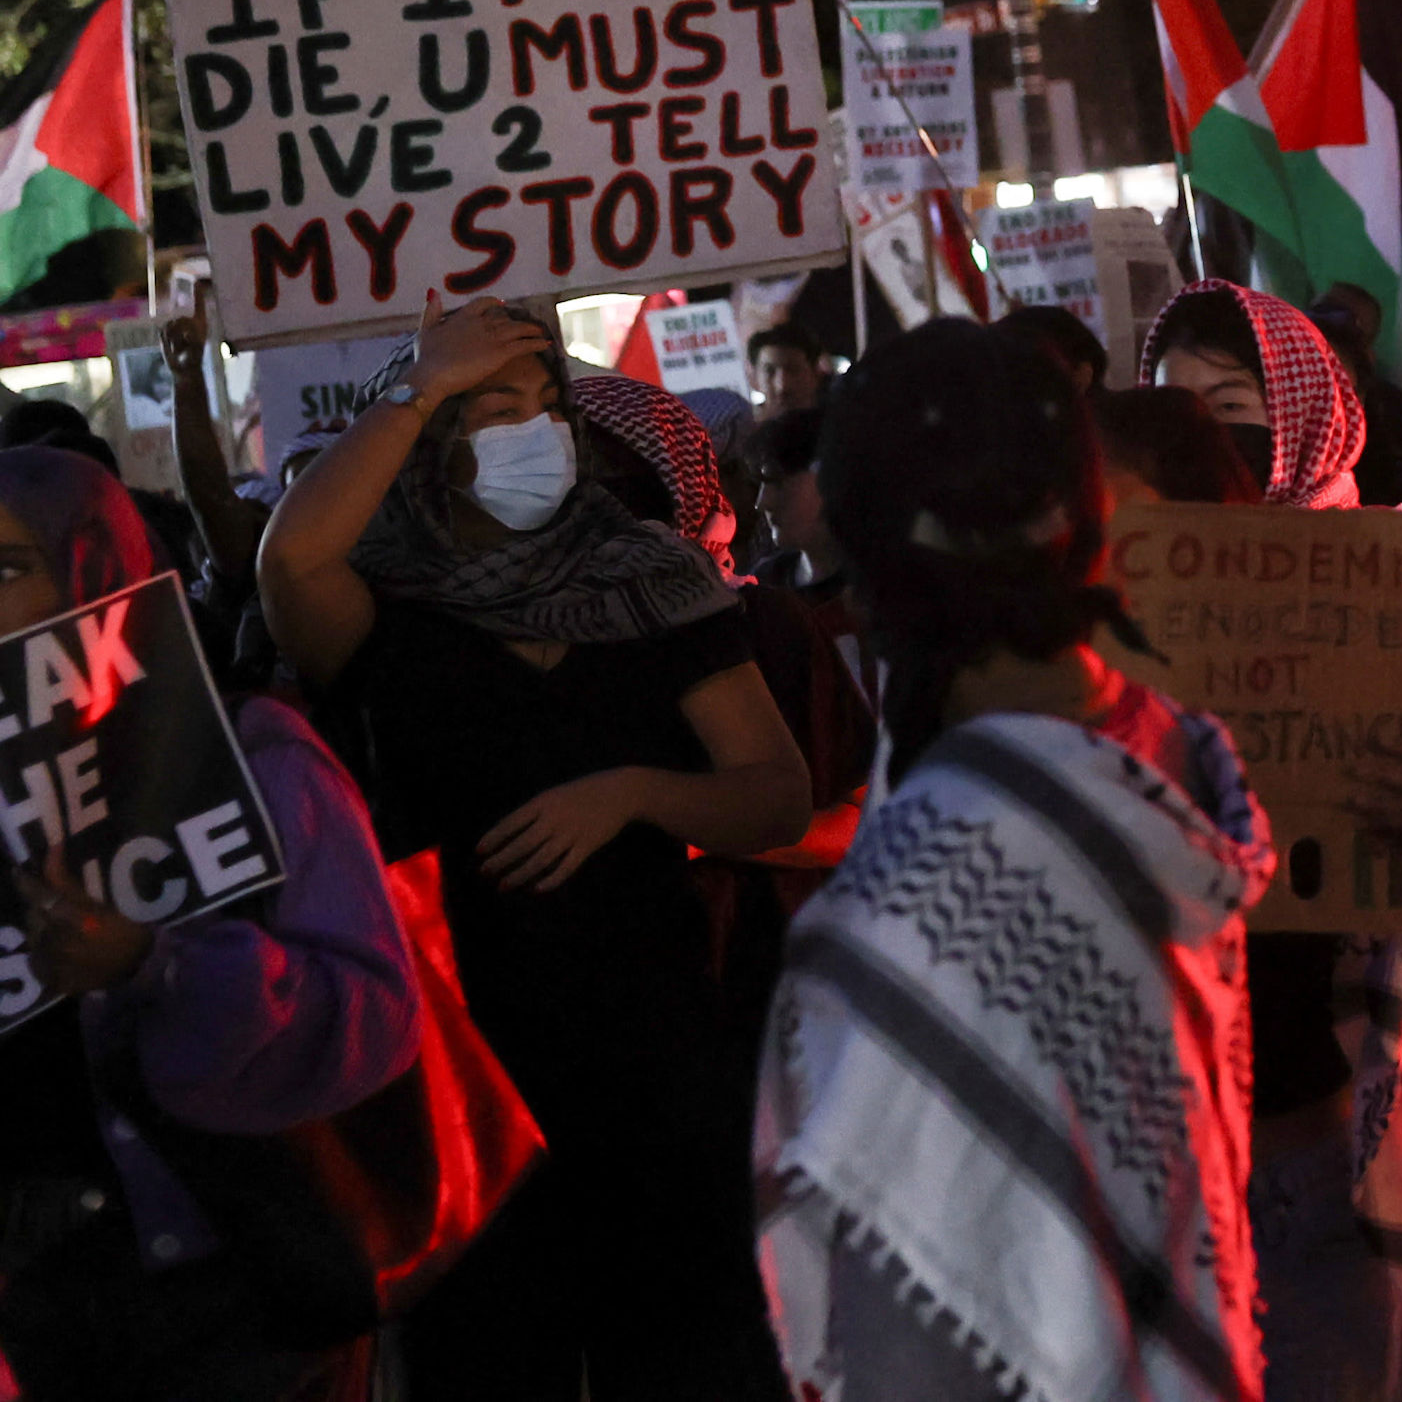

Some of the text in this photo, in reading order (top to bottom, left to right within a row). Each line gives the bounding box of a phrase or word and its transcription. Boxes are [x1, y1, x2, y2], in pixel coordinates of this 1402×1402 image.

[185, 32, 389, 132] DIE,
[418, 29, 490, 112] U
[205, 85, 817, 213] LIVE 2 TELL
[252, 154, 814, 312] MY STORY
[1205, 655, 1309, 696] NOT
